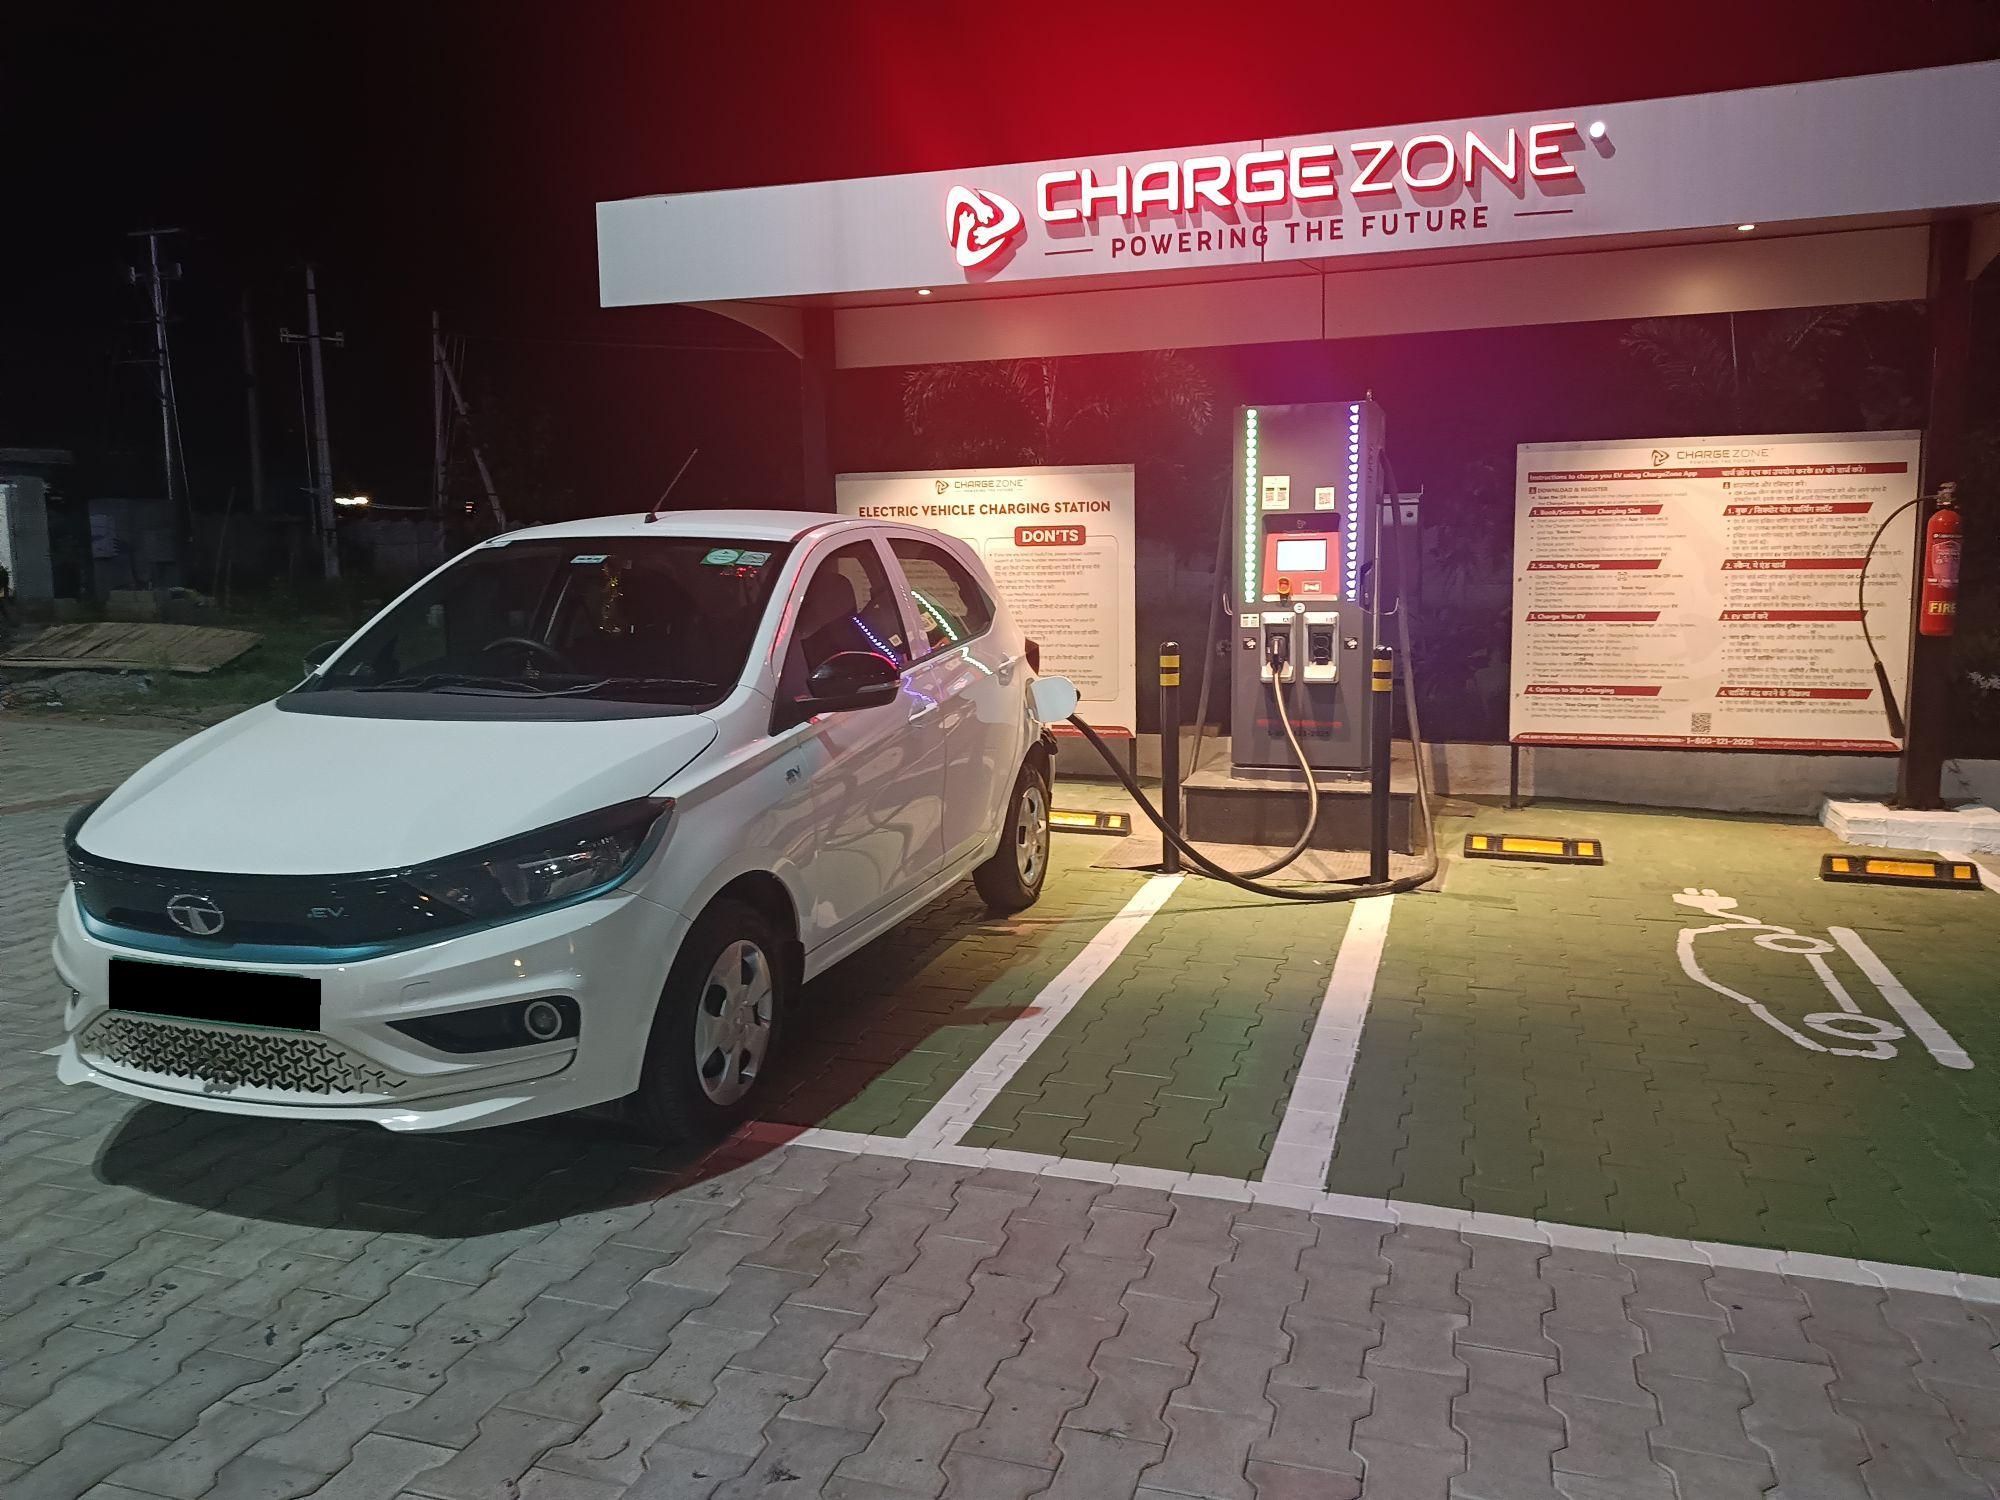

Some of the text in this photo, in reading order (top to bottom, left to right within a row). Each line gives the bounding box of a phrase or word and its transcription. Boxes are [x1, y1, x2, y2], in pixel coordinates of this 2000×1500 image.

[1111, 205, 1489, 259] POWERING THE FUTURE
[1683, 470, 1698, 478] App
[858, 500, 1111, 518] ELECTRIC VEHICLE CHARGING STATION
[1021, 529, 1079, 543] DON'TS
[1686, 737, 1755, 746] 1-800-121-2025
